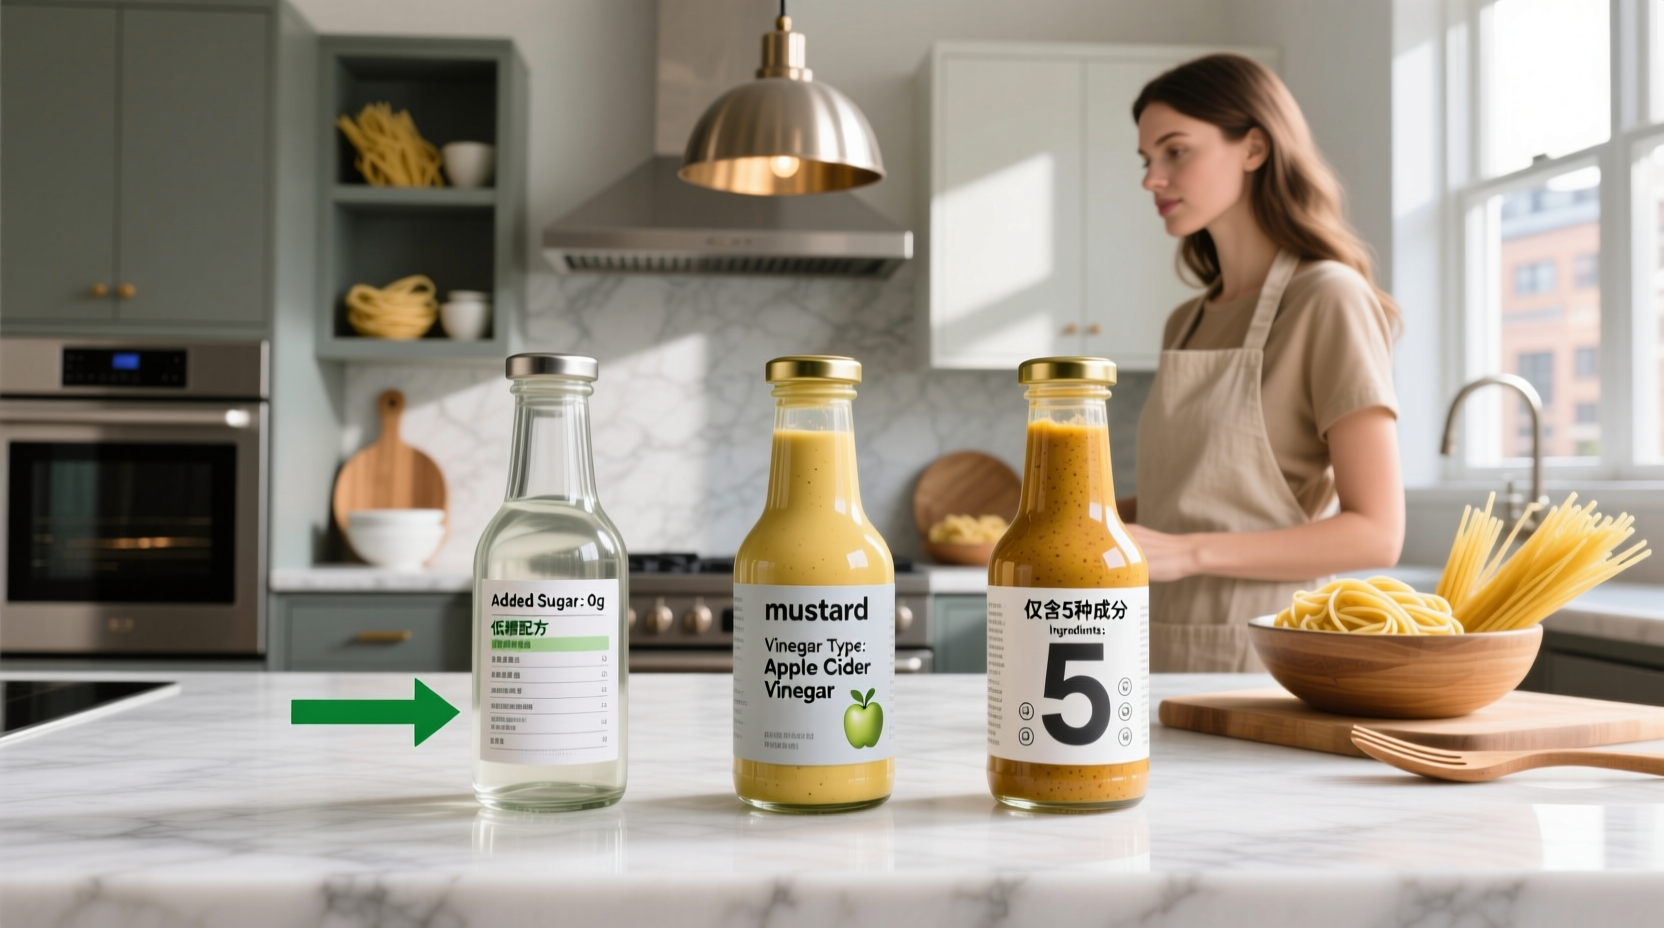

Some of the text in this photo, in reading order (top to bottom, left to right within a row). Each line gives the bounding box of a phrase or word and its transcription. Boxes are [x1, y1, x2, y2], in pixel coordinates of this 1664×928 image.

[491, 592, 605, 611] Added Sugar: 0g
[765, 596, 868, 621] mustard
[1024, 598, 1128, 621] 仅含5种成分
[764, 637, 866, 657] Vinegar Type:
[764, 657, 872, 680] Apple Cider
[764, 680, 835, 704] Vinegar
[1041, 643, 1111, 746] 5
